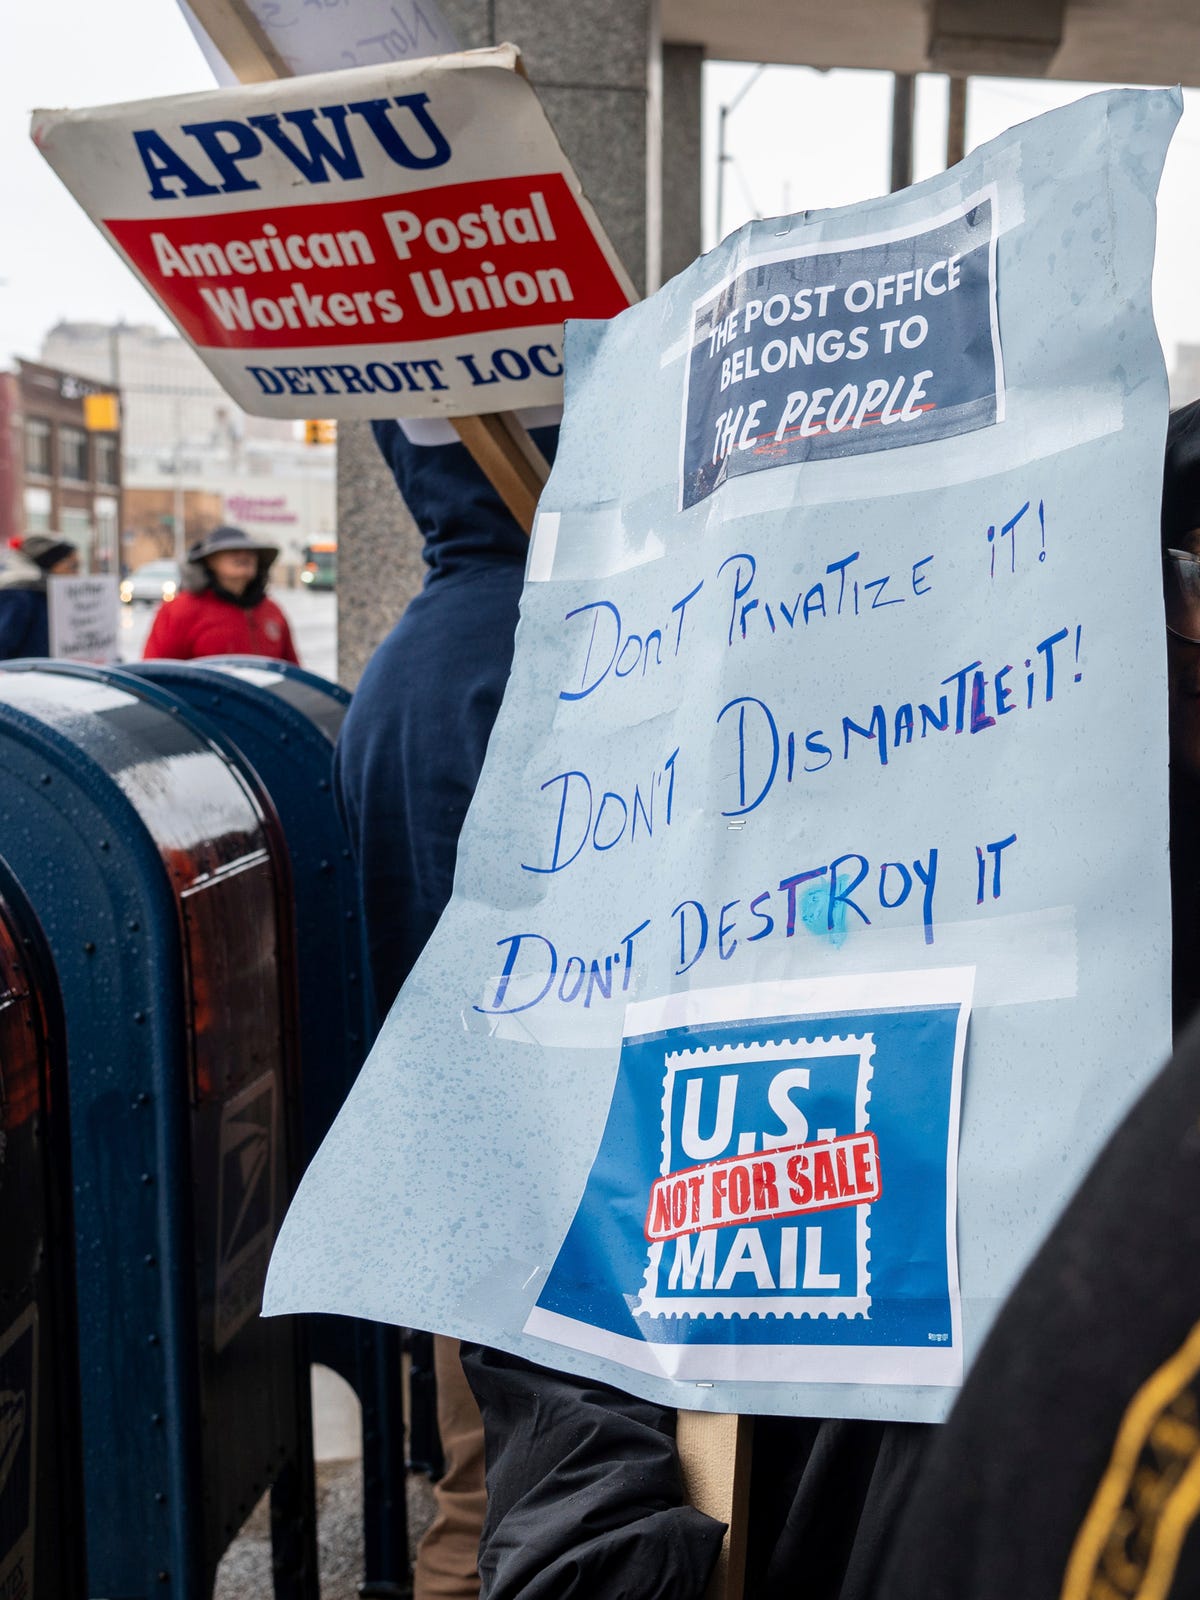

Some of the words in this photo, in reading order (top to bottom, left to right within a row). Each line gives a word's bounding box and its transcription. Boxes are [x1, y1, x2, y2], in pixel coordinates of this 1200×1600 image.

[133, 92, 452, 200] APWU
[150, 223, 375, 278] American
[382, 191, 557, 260] Postal
[201, 281, 404, 332] Workers
[410, 260, 574, 318] Union
[708, 307, 739, 358] THE
[744, 285, 836, 334] POST
[844, 253, 962, 313] OFFICE
[245, 358, 444, 396] DETROIT
[457, 343, 564, 385] LOC
[720, 325, 870, 393] BELONGS
[880, 314, 929, 355] TO
[712, 399, 768, 465] THE
[774, 370, 934, 442] PEOPLE
[671, 848, 939, 976] DESTROY
[975, 833, 1018, 905] IT
[680, 1068, 837, 1160] U.S.
[652, 1175, 706, 1234] NOT
[711, 1160, 781, 1220] FOR
[787, 1143, 875, 1202] SALE
[667, 1226, 841, 1291] MAIL
